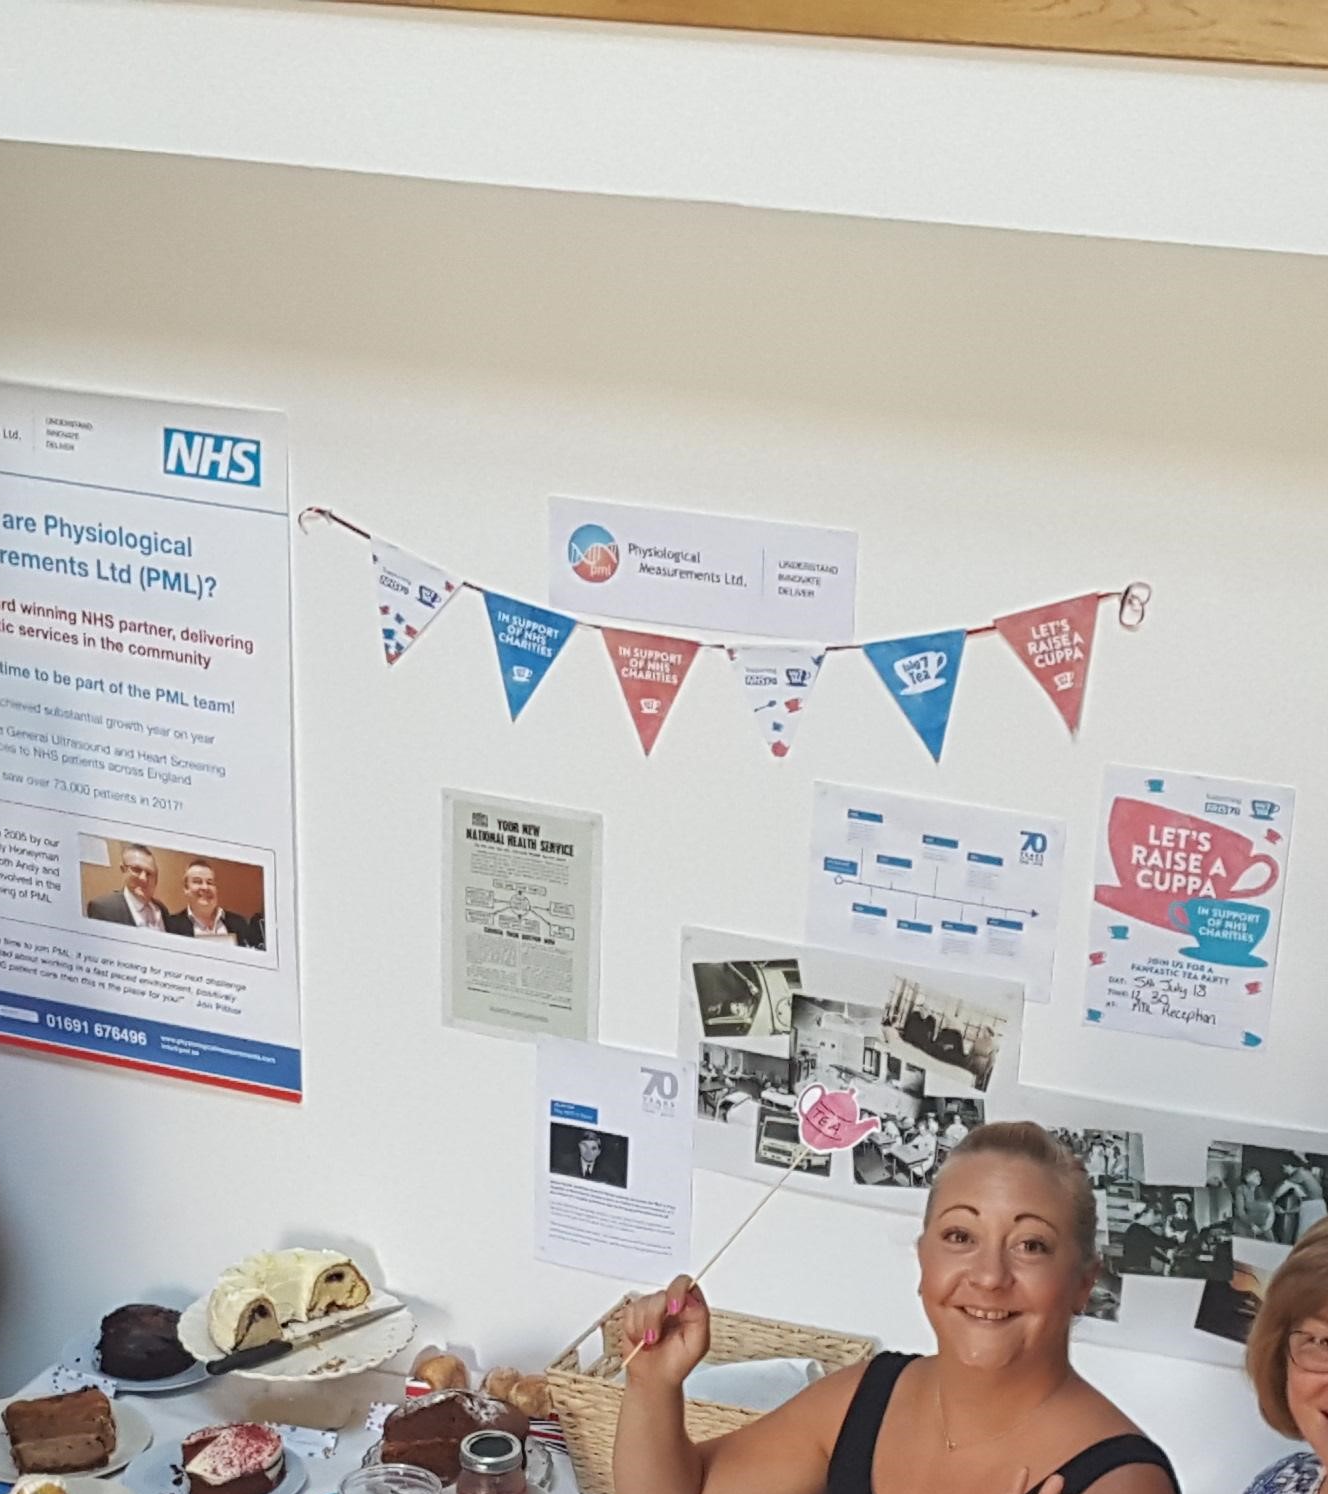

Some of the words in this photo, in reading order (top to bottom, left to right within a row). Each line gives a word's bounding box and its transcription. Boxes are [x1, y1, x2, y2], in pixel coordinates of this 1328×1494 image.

[166, 432, 258, 482] NHS
[3, 514, 37, 532] are
[44, 514, 192, 557] Physiological
[628, 543, 701, 564] Physiological
[96, 559, 132, 584] Ltd
[139, 566, 216, 600] (PML)?
[638, 562, 721, 584] Measurements
[724, 572, 748, 587] Ltd.
[20, 603, 76, 625] winning
[82, 610, 114, 629] NHS
[119, 619, 176, 641] partner,
[181, 627, 254, 655] delivering
[497, 610, 510, 624] IN
[512, 614, 559, 639] SUPPORT
[507, 624, 521, 637] OF
[524, 629, 546, 645] NHS
[1032, 618, 1070, 640] LET'S
[19, 625, 78, 645] services
[83, 633, 96, 648] in
[100, 637, 124, 652] the
[128, 642, 211, 670] community
[498, 632, 552, 658] CHARITIES
[618, 646, 631, 658] IN
[632, 649, 682, 666] SUPPORT
[1027, 633, 1071, 656] RAISE
[1073, 631, 1085, 646] A
[630, 659, 647, 670] OF
[649, 662, 670, 675] NHS
[1034, 646, 1084, 668] CUPPA
[0, 661, 30, 679] time
[34, 667, 49, 681] to
[53, 671, 71, 685] be
[75, 677, 104, 691] part
[109, 683, 123, 695] of
[128, 684, 151, 699] the
[156, 688, 189, 707] PML
[193, 696, 235, 714] team!
[621, 667, 677, 685] CHARITIES
[105, 717, 144, 732] growth
[146, 724, 171, 737] year
[173, 730, 188, 739] on
[191, 732, 215, 744] year
[113, 747, 135, 760] and
[33, 747, 58, 761] NHS
[147, 766, 192, 786] England
[26, 776, 50, 788] over
[93, 787, 137, 804] patients
[139, 795, 149, 806] in
[466, 828, 504, 845] NATIONAL
[507, 835, 537, 850] HEALTH
[540, 840, 575, 857] SERVICE
[522, 824, 541, 837] NEW
[1020, 830, 1047, 854] 70
[1149, 824, 1212, 852] LET'S
[1132, 844, 1203, 874] RAISE
[1209, 857, 1227, 878] A
[1136, 869, 1217, 899] CUPPA
[1198, 906, 1209, 915] IN
[1212, 908, 1260, 923] SUPPORT
[1207, 917, 1222, 928] OF
[1225, 920, 1247, 932] NHS
[1198, 926, 1254, 943] CHARITIES
[1131, 963, 1178, 977] FANTASTIC
[1182, 970, 1198, 981] TEA
[1201, 974, 1229, 986] PARTY
[1172, 961, 1184, 969] US
[1187, 962, 1205, 971] FOR
[1208, 966, 1214, 974] A
[1152, 991, 1170, 1005] 30
[1159, 979, 1188, 1000] July
[1161, 1004, 1216, 1025] Reception
[47, 1013, 89, 1034] 01691
[94, 1022, 148, 1046] 676496
[640, 1066, 679, 1100] 70
[813, 1106, 841, 1136] TEA
